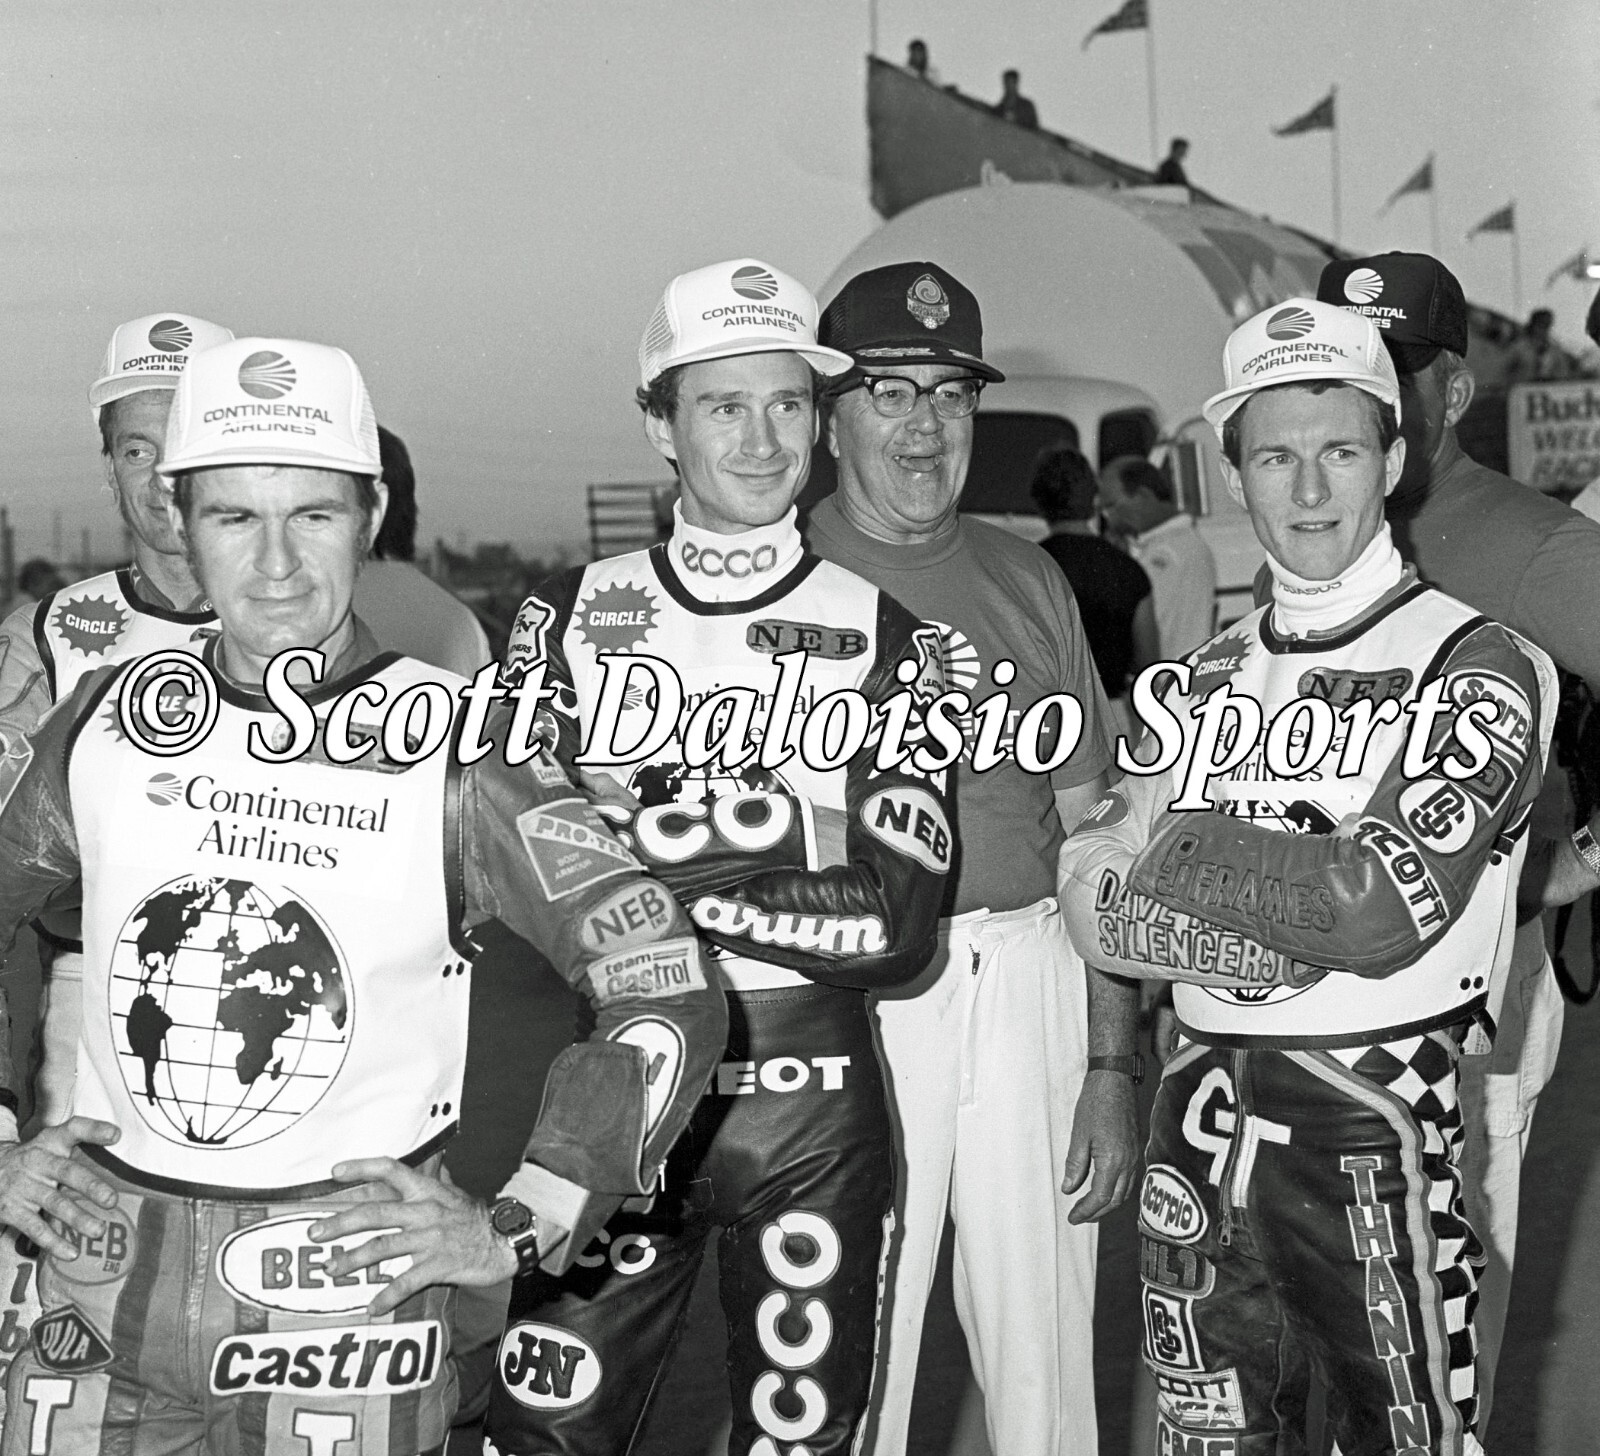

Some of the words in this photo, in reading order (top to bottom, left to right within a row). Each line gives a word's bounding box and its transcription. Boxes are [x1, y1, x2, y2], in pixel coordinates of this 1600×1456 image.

[701, 304, 807, 328] CONTINENTAL
[722, 315, 798, 334] AIRLINES
[1241, 343, 1350, 374] CONTINENTAL
[1254, 353, 1333, 376] AIRLINES
[203, 404, 334, 424] CONTINENTAL
[681, 540, 778, 579] ecco
[64, 613, 118, 635] CIRCLE
[588, 610, 647, 627] CIRCLE
[752, 624, 865, 655] NEB
[1194, 655, 1240, 677] CIRCLE
[184, 775, 390, 833] Continental
[196, 819, 340, 870] Airlines
[874, 796, 950, 864] NEB
[590, 886, 668, 944] NEB
[693, 896, 887, 952] arum
[604, 953, 652, 975] team
[1098, 914, 1279, 984] SILENCERS
[606, 958, 691, 997] Castrol
[717, 1055, 851, 1096] EOT
[1142, 1174, 1193, 1231] Scorpio
[213, 1332, 438, 1391] Castrol
[1156, 1372, 1231, 1400] COTT
